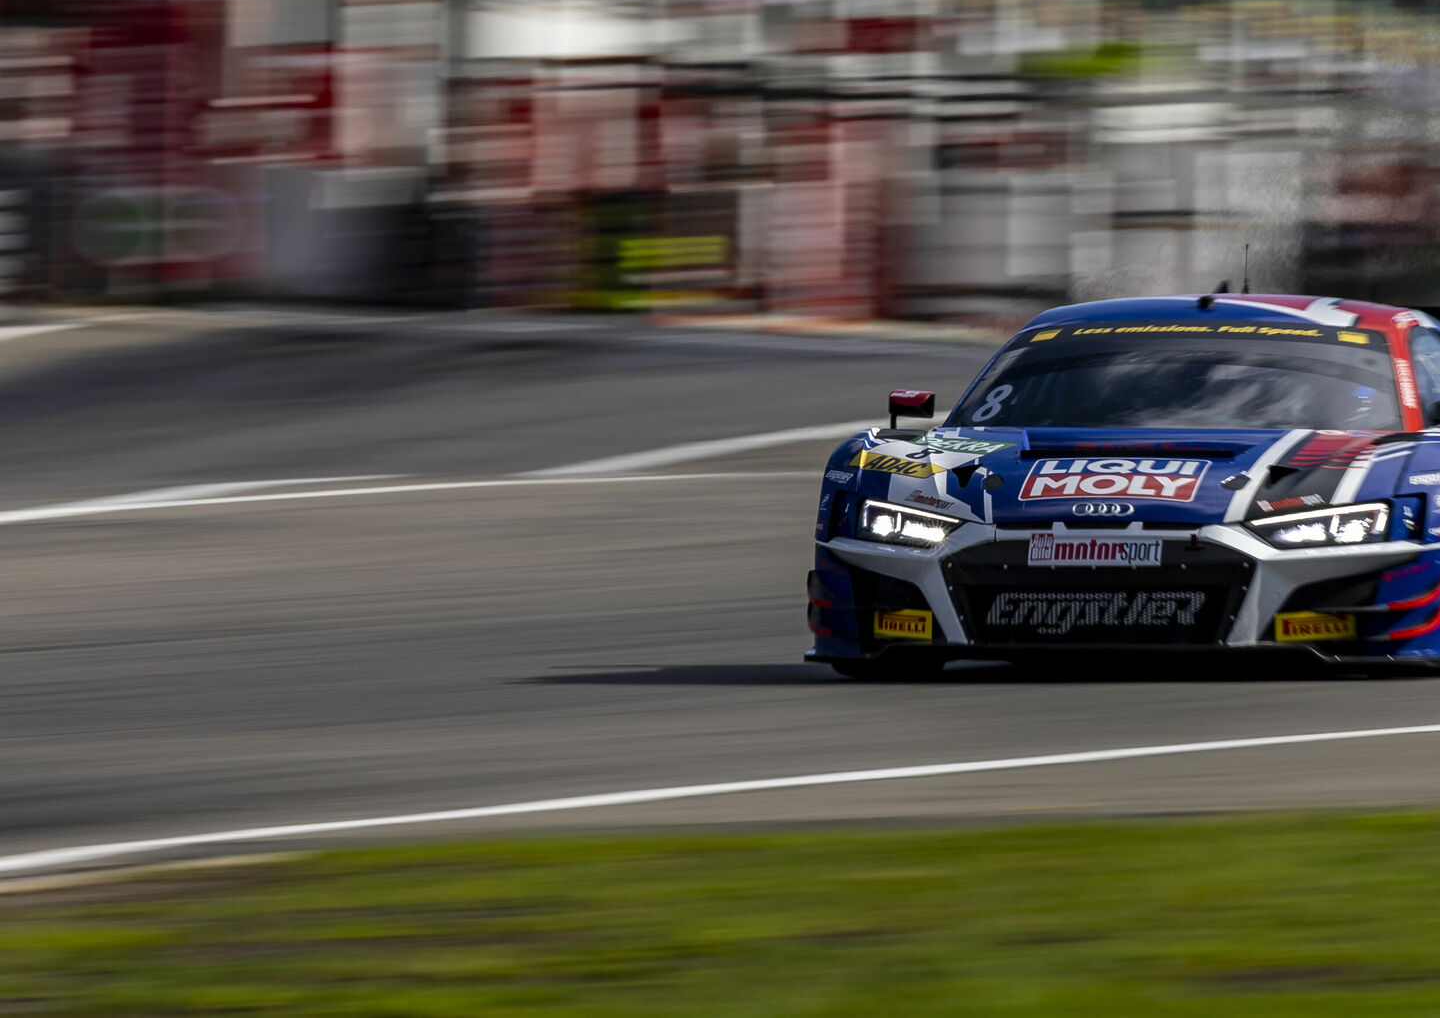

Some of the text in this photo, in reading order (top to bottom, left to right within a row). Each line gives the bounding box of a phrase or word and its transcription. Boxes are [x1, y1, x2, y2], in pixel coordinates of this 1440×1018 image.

[1073, 327, 1113, 336] Less
[1217, 325, 1255, 334] Full
[971, 384, 1014, 423] 8
[863, 454, 928, 475] ADAC
[1039, 459, 1200, 476] LIQUI
[1029, 474, 1196, 497] MOLY
[1053, 538, 1161, 565] motorsport
[877, 610, 927, 634] PIRELLI
[1281, 613, 1351, 636] PIRELLI
